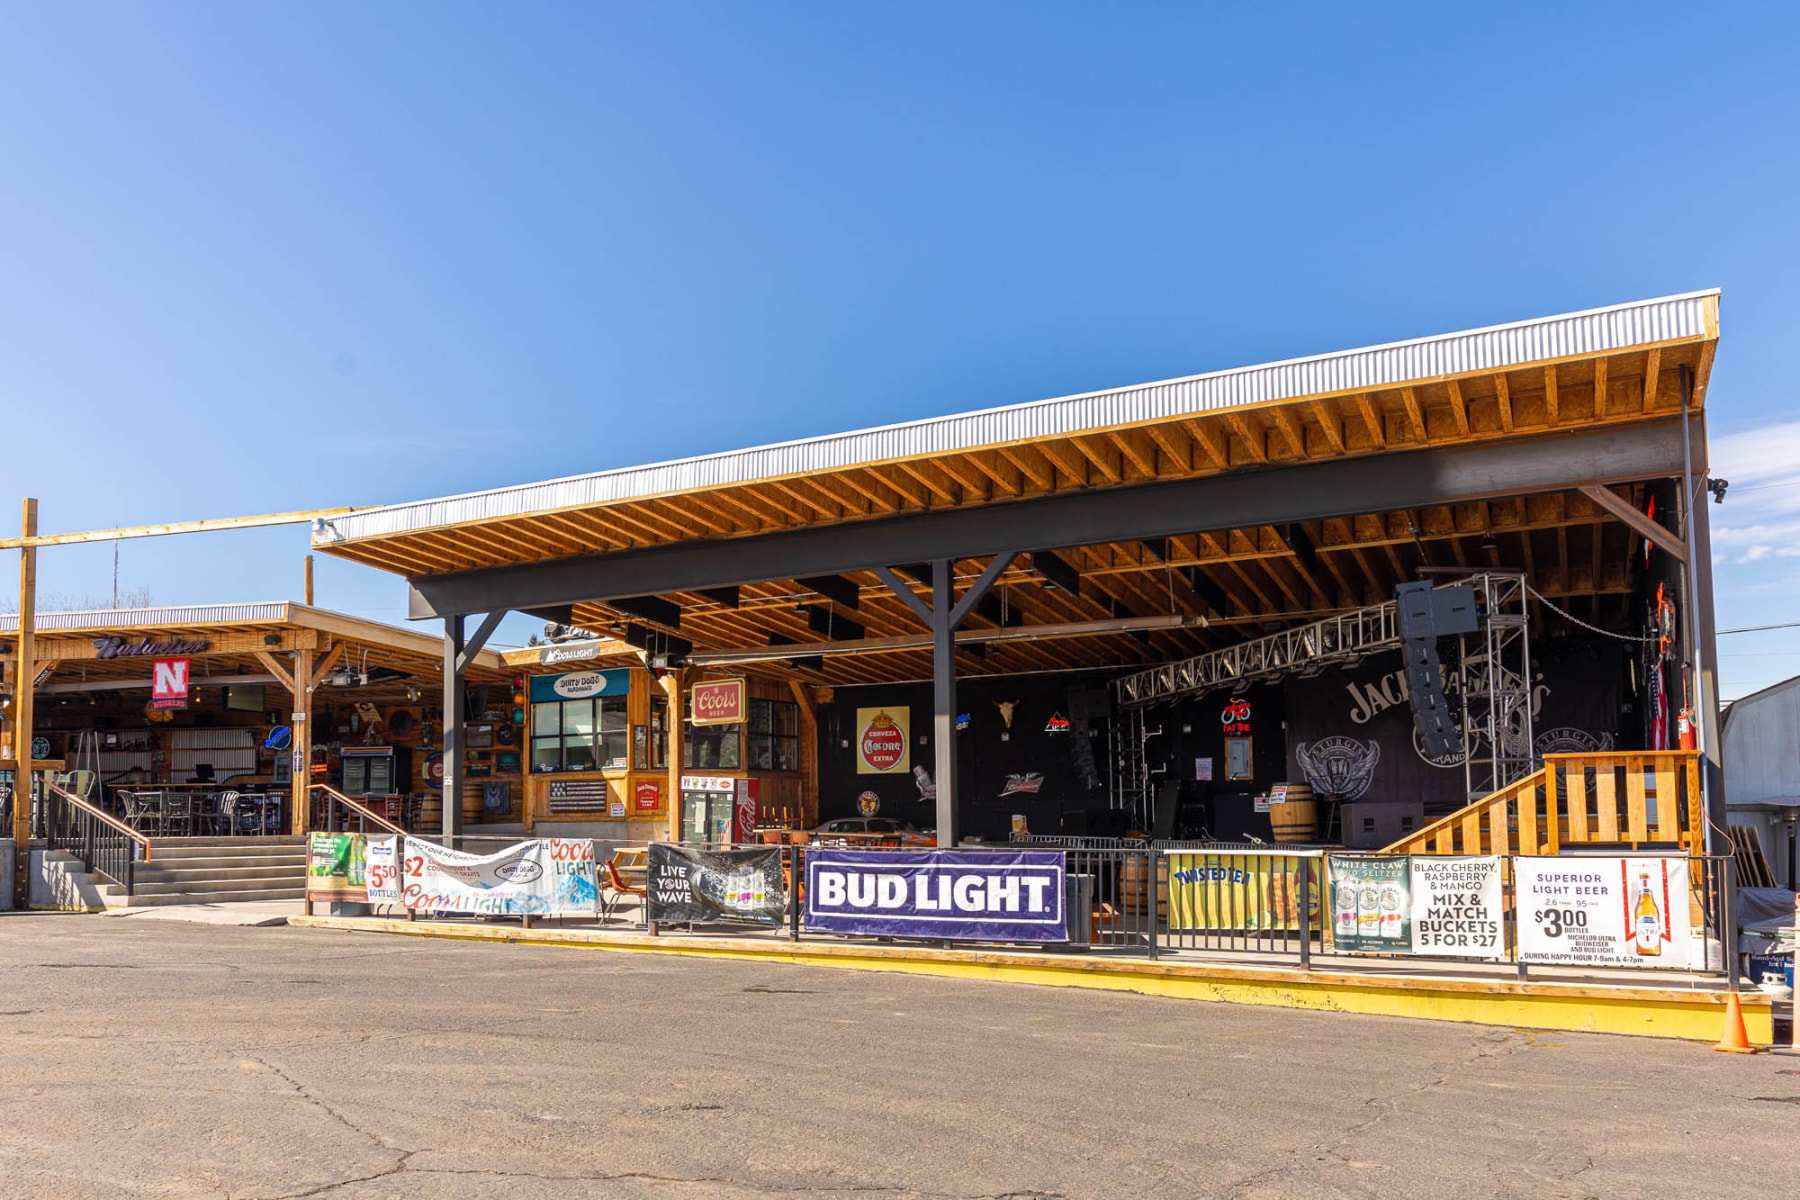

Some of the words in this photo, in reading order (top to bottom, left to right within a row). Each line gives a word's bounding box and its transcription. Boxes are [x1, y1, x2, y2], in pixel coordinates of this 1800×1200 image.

[92, 636, 209, 659] Budweiser
[573, 648, 594, 659] LIGHT
[155, 661, 185, 693] N
[560, 678, 581, 688] DIRTY
[580, 675, 600, 686] DOGS
[154, 700, 185, 709] HUSKERS
[698, 690, 736, 711] Coors
[709, 709, 725, 717] BEER
[863, 738, 901, 755] Corona
[1311, 738, 1364, 755] STURGIS
[1536, 731, 1596, 752] STURGIS
[427, 847, 444, 855] OUR
[404, 855, 424, 877] $2
[556, 861, 592, 875] LIGHT
[660, 865, 688, 878] LIVE
[1332, 861, 1369, 869] WHITE
[1372, 862, 1404, 870] CLAW
[1414, 863, 1449, 872] BLACK
[1450, 863, 1498, 873] CHERRY,
[1174, 867, 1227, 886] TWISTED
[1362, 869, 1403, 877] SELTZER
[1424, 872, 1488, 881] RASPBERRY
[1536, 873, 1602, 883] SUPERIOR
[656, 878, 691, 890] YOUR
[818, 871, 908, 909] BUD
[1430, 881, 1437, 890] &
[1440, 881, 1483, 890] MANGO
[369, 889, 398, 898] BOTTLES
[1532, 885, 1570, 895] LIGHT
[1575, 886, 1609, 896] BEER
[656, 891, 692, 903] WAVE
[1433, 893, 1465, 906] MIX
[1470, 893, 1481, 906] &
[1544, 898, 1558, 907] 2.6
[1575, 900, 1588, 908] 95
[1427, 907, 1488, 919] MATCH
[1419, 920, 1498, 933] BUCKETS
[1420, 933, 1429, 946] 5
[1433, 934, 1468, 947] FOR
[1472, 935, 1497, 947] $27
[1567, 934, 1598, 942] MICHELOB
[1524, 952, 1550, 960] DURING
[1550, 953, 1572, 961] HAPPY
[1573, 954, 1593, 962] HOUR
[1593, 955, 1615, 963] 7-9am
[1622, 956, 1645, 964] 4-7pm
